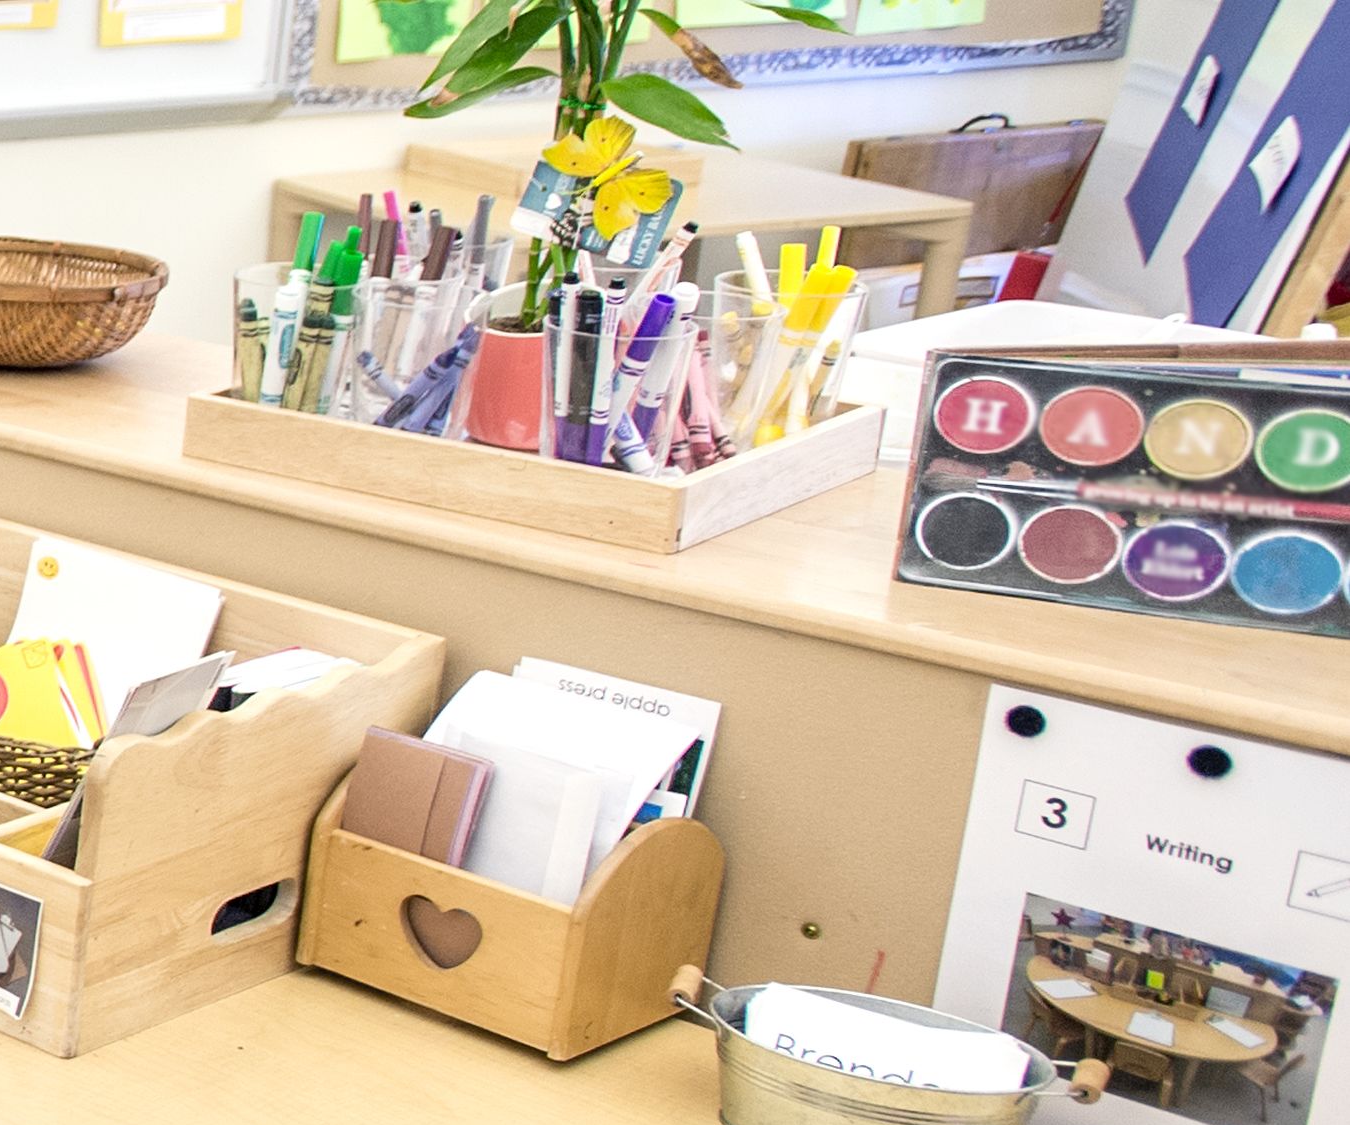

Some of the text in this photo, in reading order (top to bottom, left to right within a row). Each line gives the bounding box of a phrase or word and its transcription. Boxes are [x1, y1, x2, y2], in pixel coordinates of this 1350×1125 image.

[558, 678, 671, 718] apple press
[1040, 797, 1068, 829] 3
[1146, 834, 1233, 874] Writing
